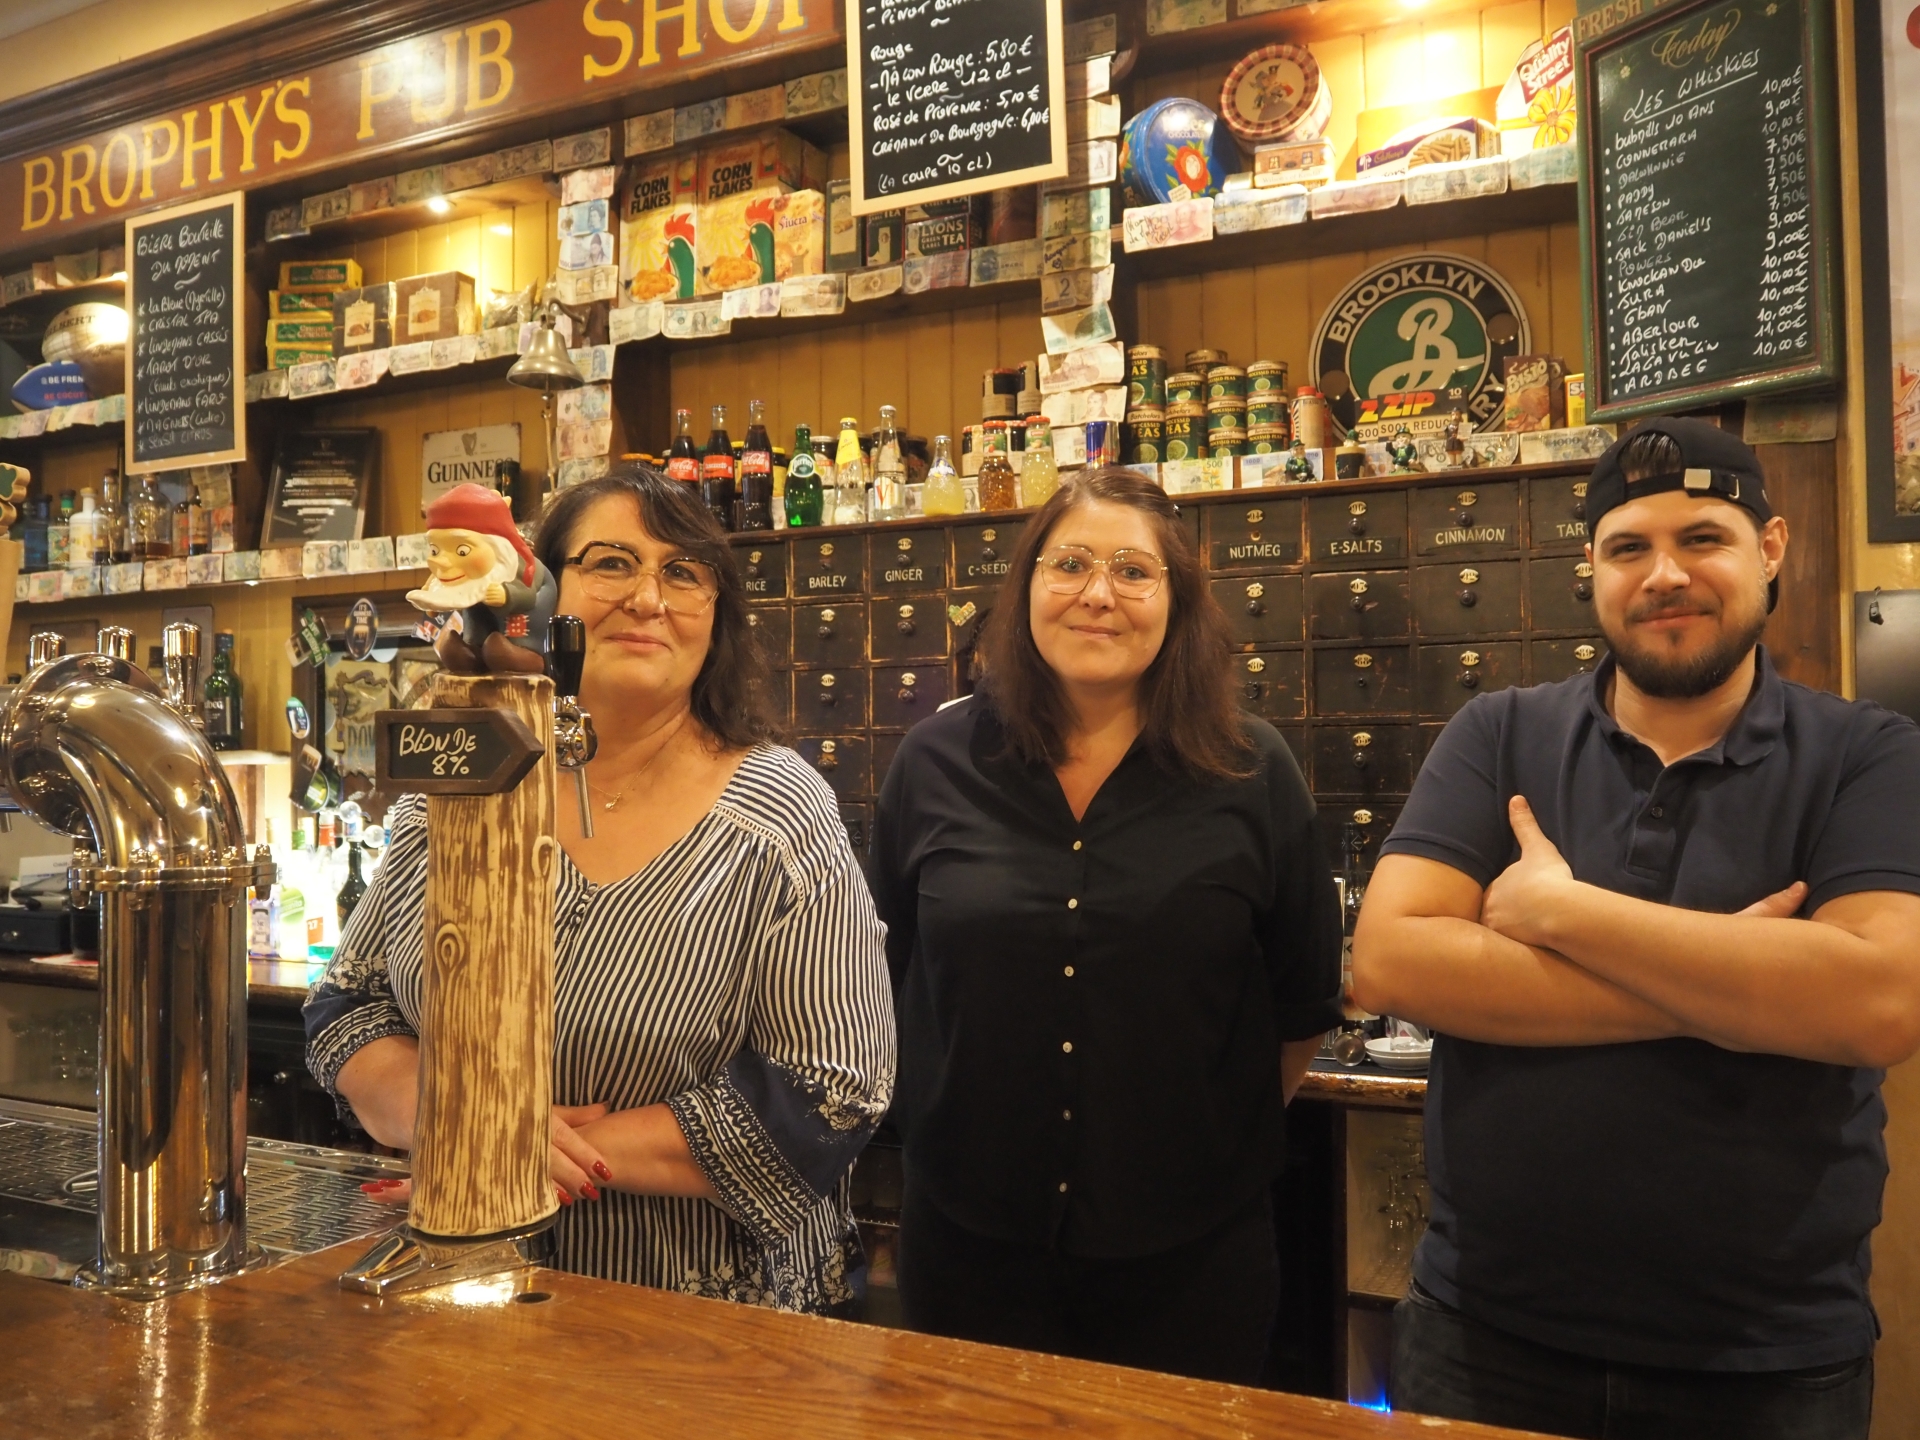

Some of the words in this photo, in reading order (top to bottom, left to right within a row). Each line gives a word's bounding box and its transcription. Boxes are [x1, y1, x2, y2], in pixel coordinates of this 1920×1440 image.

[1652, 9, 1741, 68] Today
[1518, 40, 1571, 85] Quality
[1525, 57, 1573, 96] Street
[1624, 90, 1665, 122] LES
[1688, 100, 1715, 120] ANS
[21, 78, 311, 231] BROPHY'S
[356, 20, 514, 139] PUB
[712, 161, 754, 184] CORN
[634, 176, 669, 200] CORN
[709, 177, 754, 201] FLAKES
[631, 192, 671, 215] FLAKES
[921, 220, 963, 238] LYONS
[942, 233, 965, 246] TEA
[1059, 277, 1070, 297] 2
[1328, 264, 1486, 344] BROOKLYN
[48, 376, 60, 384] BE
[1506, 361, 1549, 395] BISTO
[1380, 393, 1435, 418] ZIP
[1448, 388, 1462, 396] 10
[1380, 421, 1408, 435] SOOT
[1074, 447, 1086, 460] 10
[427, 457, 514, 485] GUINNE
[1206, 460, 1223, 469] 500
[1435, 528, 1506, 545] CINNAMON
[1229, 544, 1281, 559] NUTMEG
[1330, 539, 1383, 556] E-SALTS
[745, 581, 767, 592] RICE
[809, 574, 847, 592] BARLEY
[885, 568, 923, 585] GINGER
[356, 616, 368, 625] TIME
[400, 724, 476, 756] BLONDE
[432, 755, 470, 775] 8%
